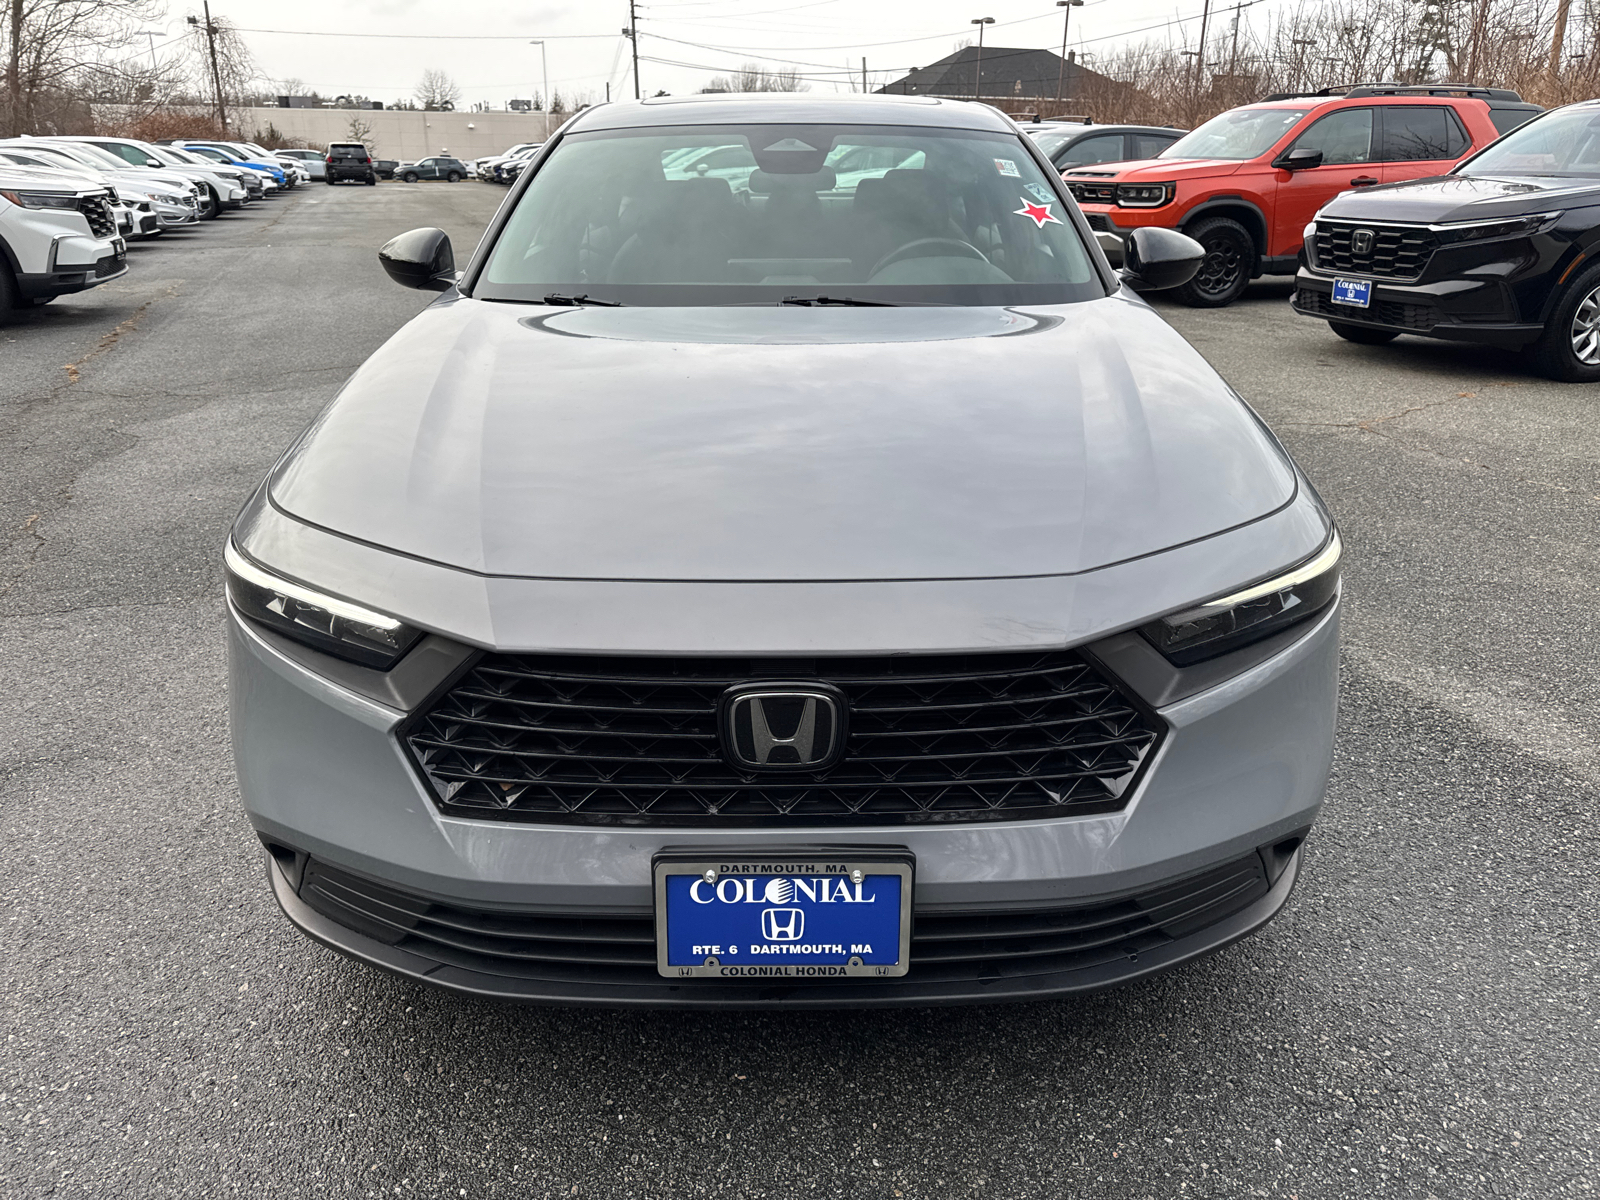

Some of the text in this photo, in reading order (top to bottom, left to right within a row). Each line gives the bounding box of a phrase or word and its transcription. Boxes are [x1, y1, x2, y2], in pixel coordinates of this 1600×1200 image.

[720, 864, 848, 874] DARTMOUTH, MA
[689, 878, 876, 905] COLONIAL
[692, 944, 873, 956] RTE. 6 DARTMOUTH, MA
[720, 966, 848, 976] COLONIAL HONDA
